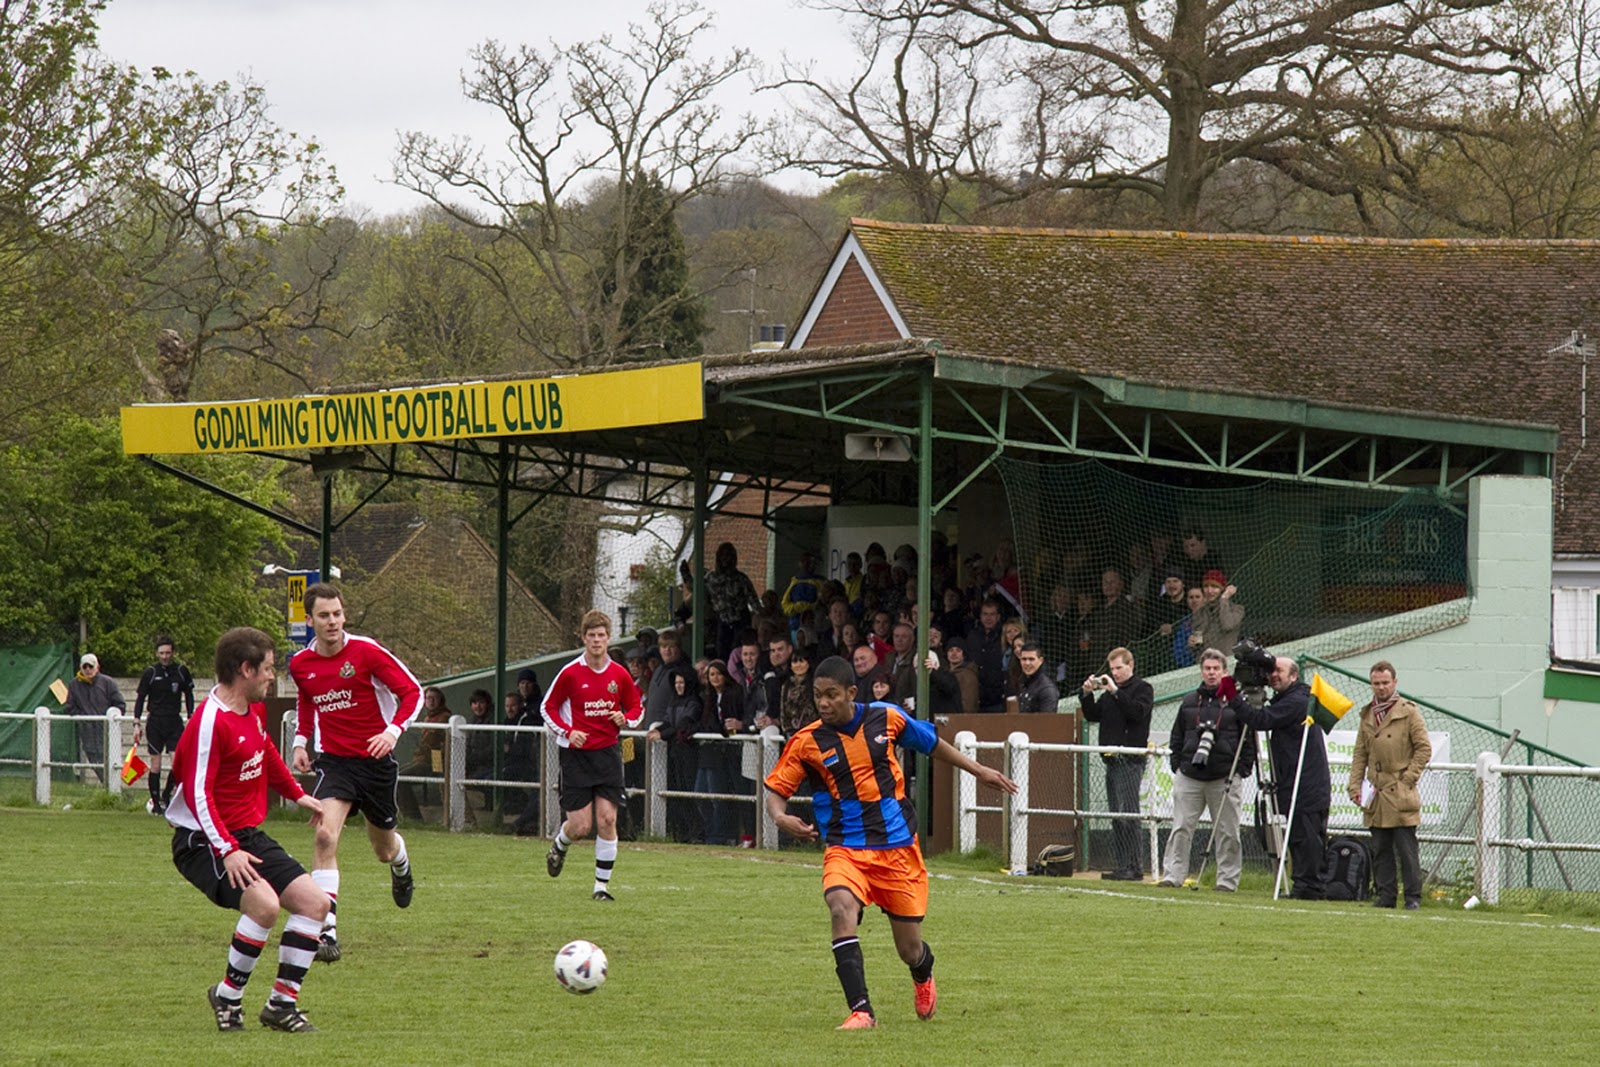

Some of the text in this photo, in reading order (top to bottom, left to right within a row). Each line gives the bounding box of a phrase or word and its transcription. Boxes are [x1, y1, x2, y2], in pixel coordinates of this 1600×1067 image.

[194, 382, 563, 450] GODALMING TOWN FOOTBALL CLUB
[312, 689, 352, 704] property
[584, 698, 616, 710] property
